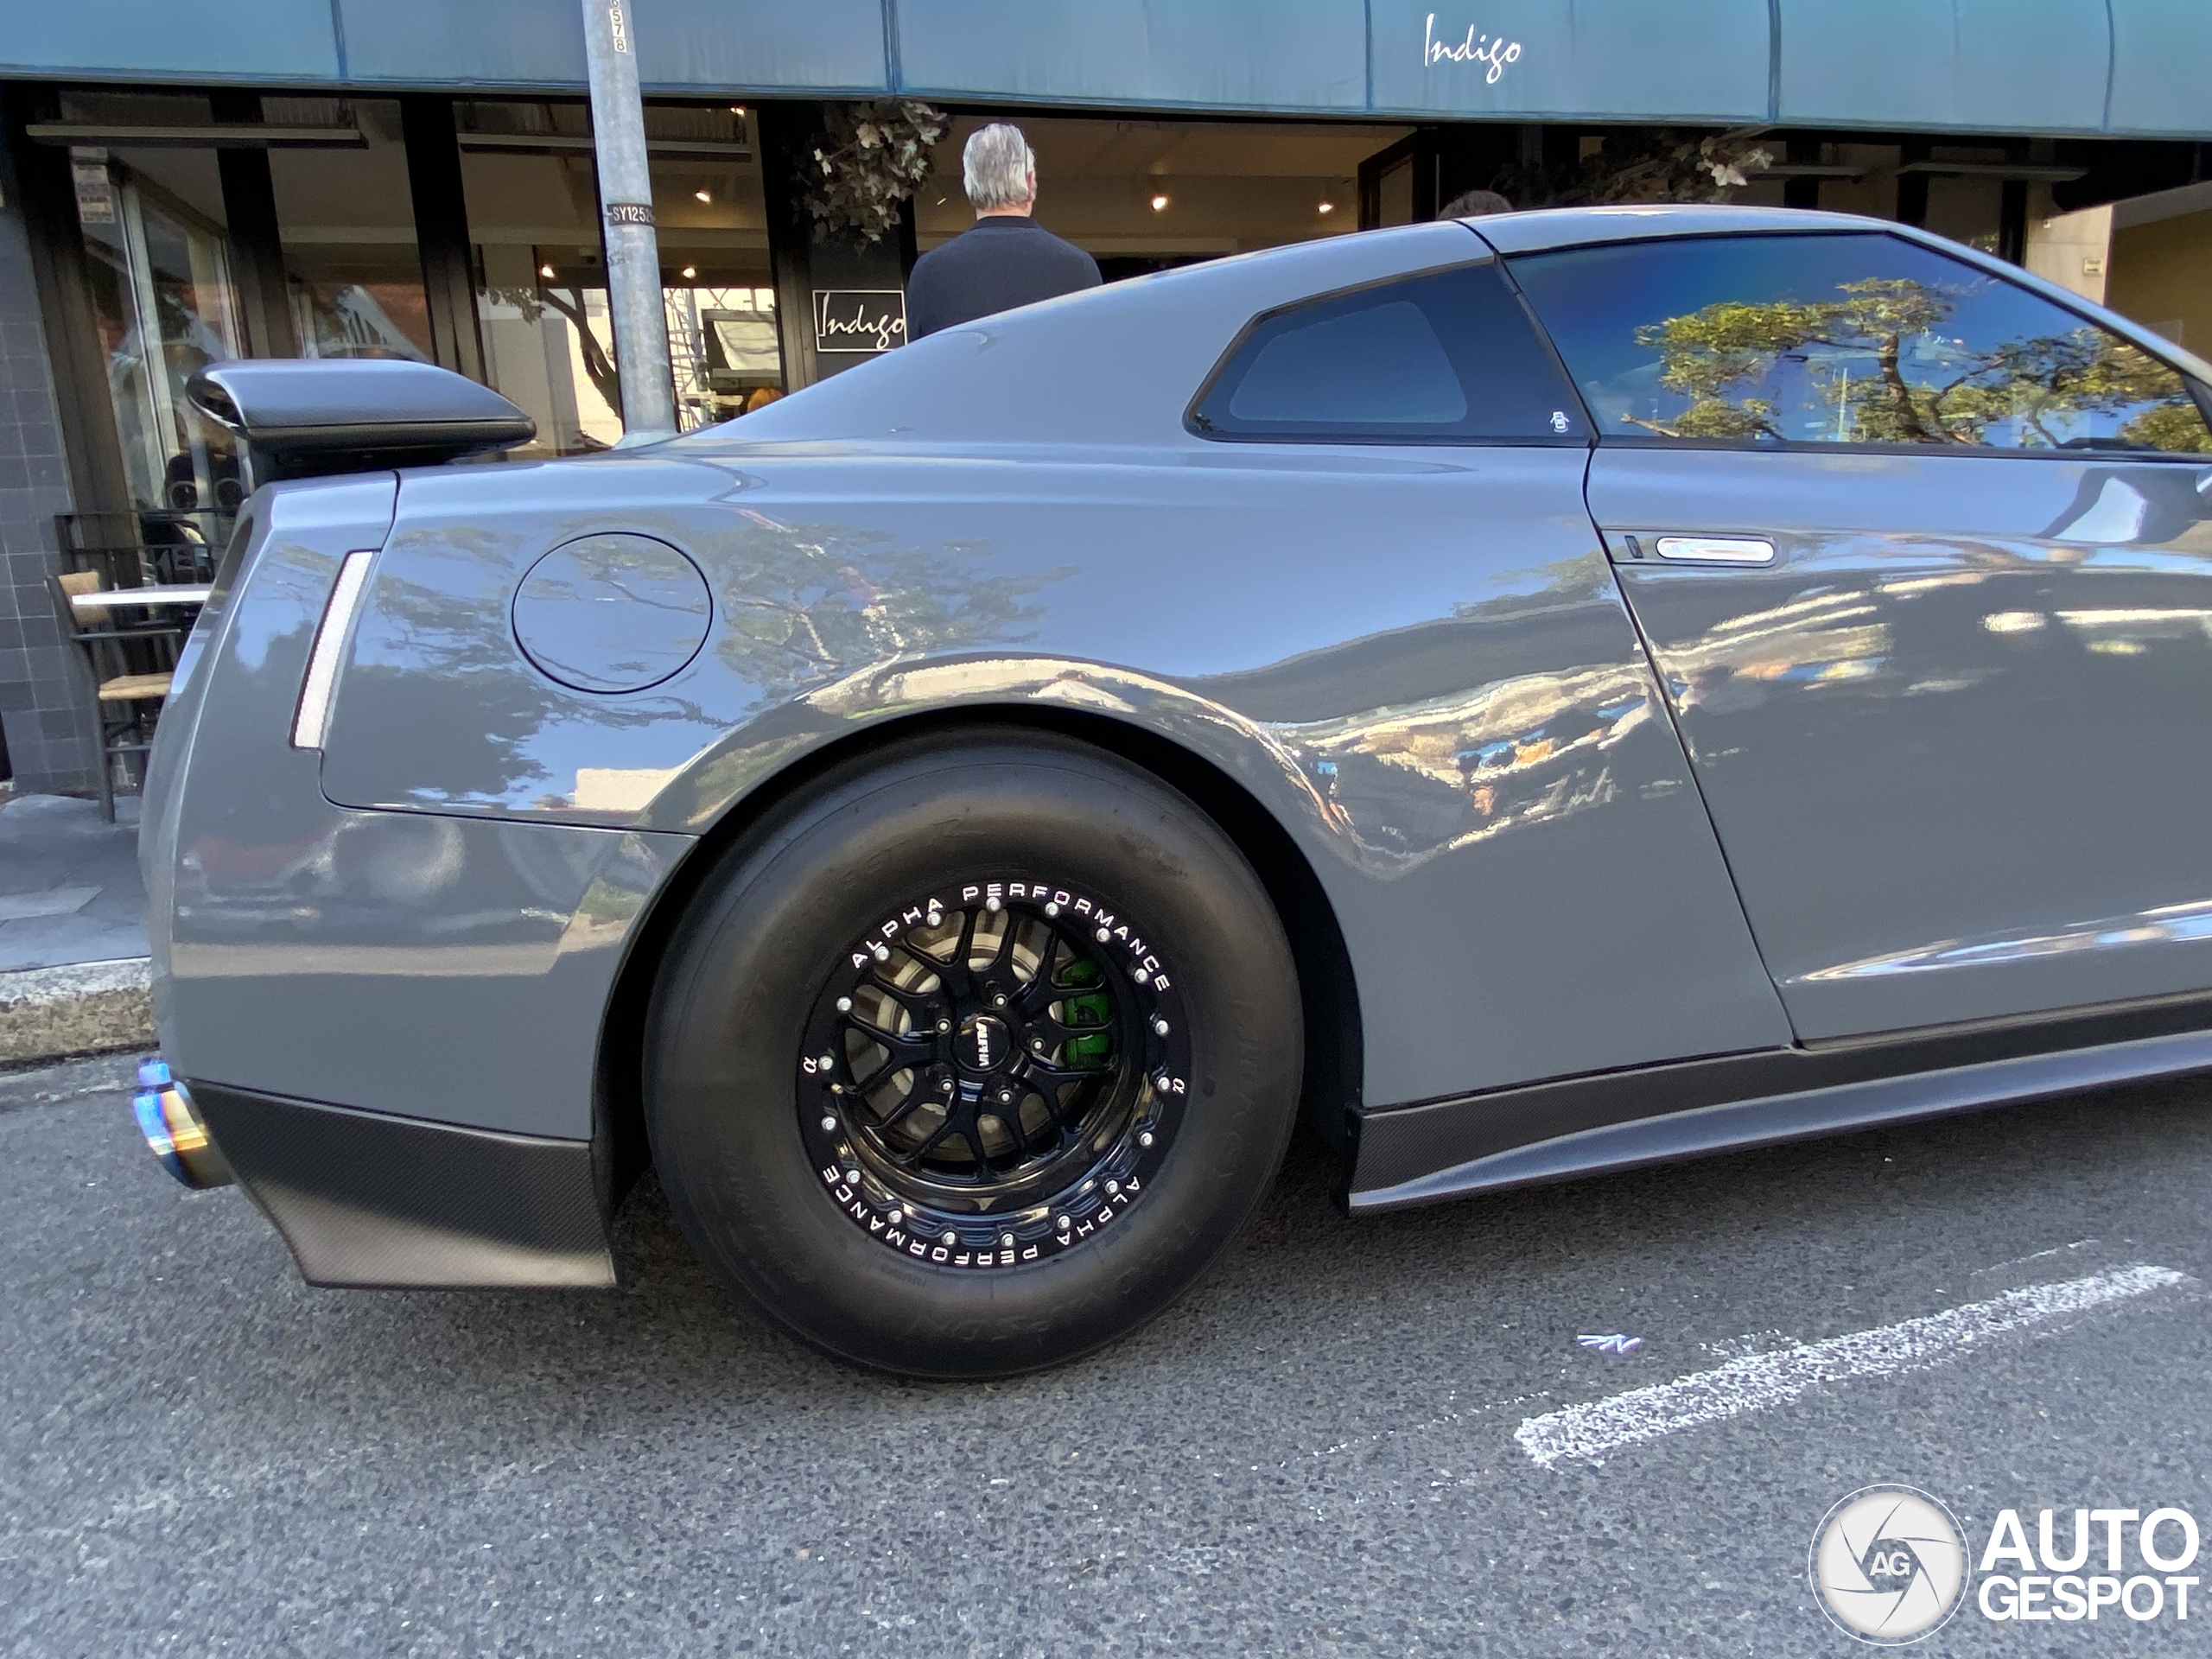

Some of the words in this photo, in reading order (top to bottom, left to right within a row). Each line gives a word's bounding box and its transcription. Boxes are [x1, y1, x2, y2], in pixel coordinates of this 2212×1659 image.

[1424, 12, 1522, 84] Indigo
[818, 292, 905, 350] Indigo
[851, 898, 944, 969] ALPHA
[963, 883, 1171, 991] PERFORMANCE
[823, 1165, 1039, 1266] PERFORMANCE
[1057, 1176, 1141, 1246] ALPHA
